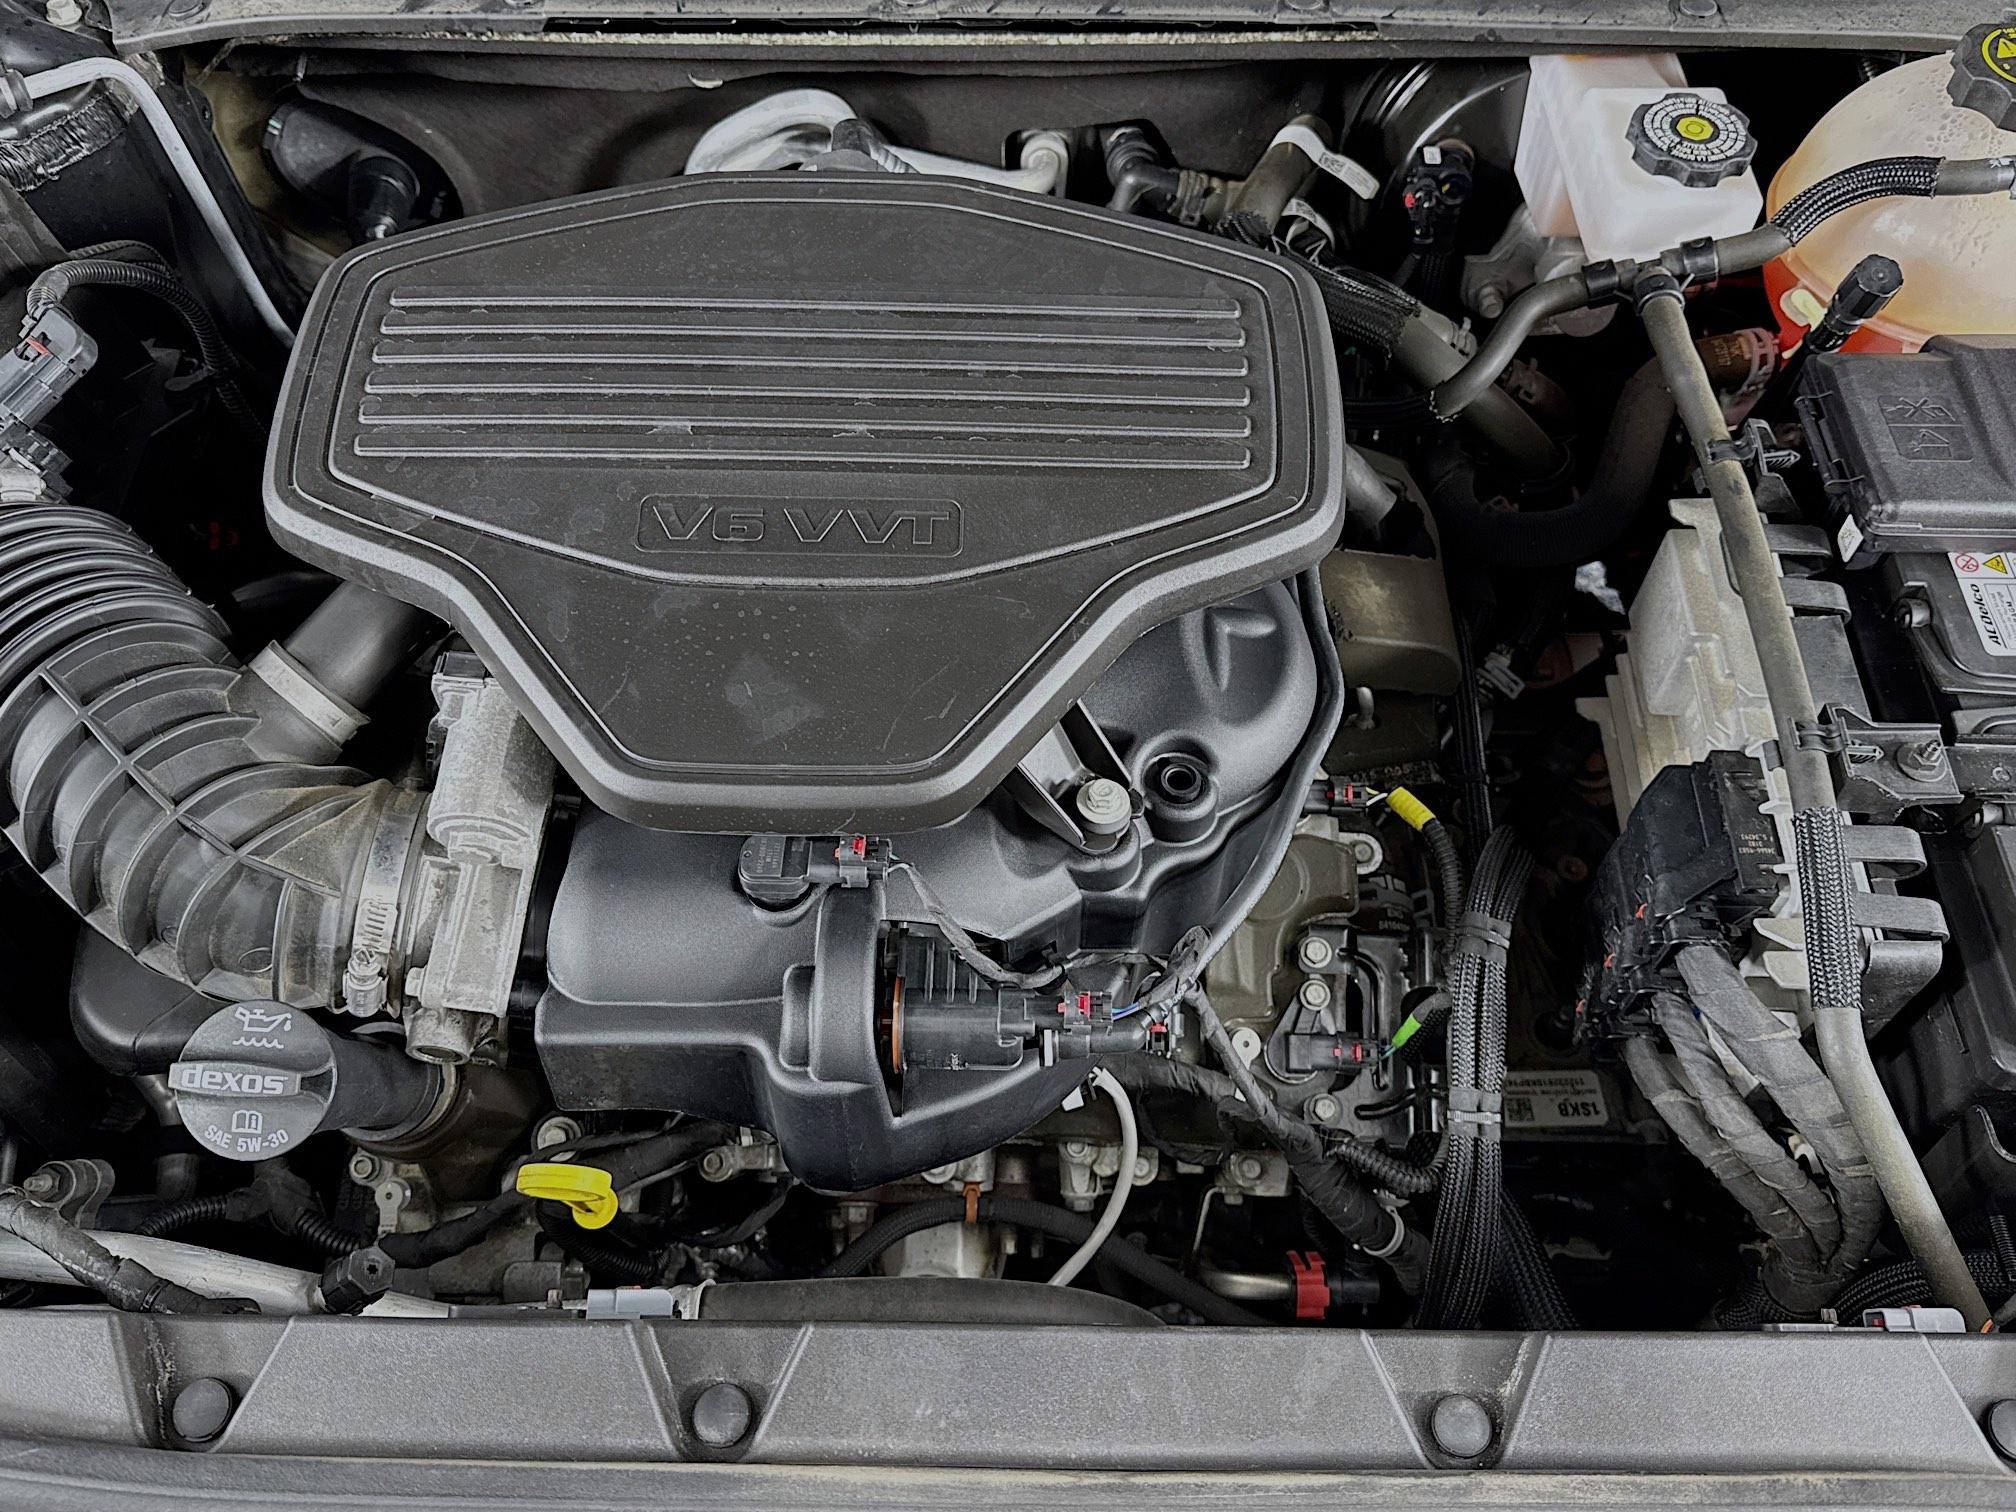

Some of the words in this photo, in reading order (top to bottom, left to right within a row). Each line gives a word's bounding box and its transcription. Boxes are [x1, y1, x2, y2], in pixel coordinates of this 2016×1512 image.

[652, 505, 765, 542] V6
[783, 507, 949, 544] VVT
[1970, 583, 2002, 646] ACDelco
[181, 1065, 286, 1095] dexos
[1557, 1101, 1600, 1117] 1SKB
[204, 1124, 232, 1149] SAE
[236, 1129, 289, 1152] 5W-30
